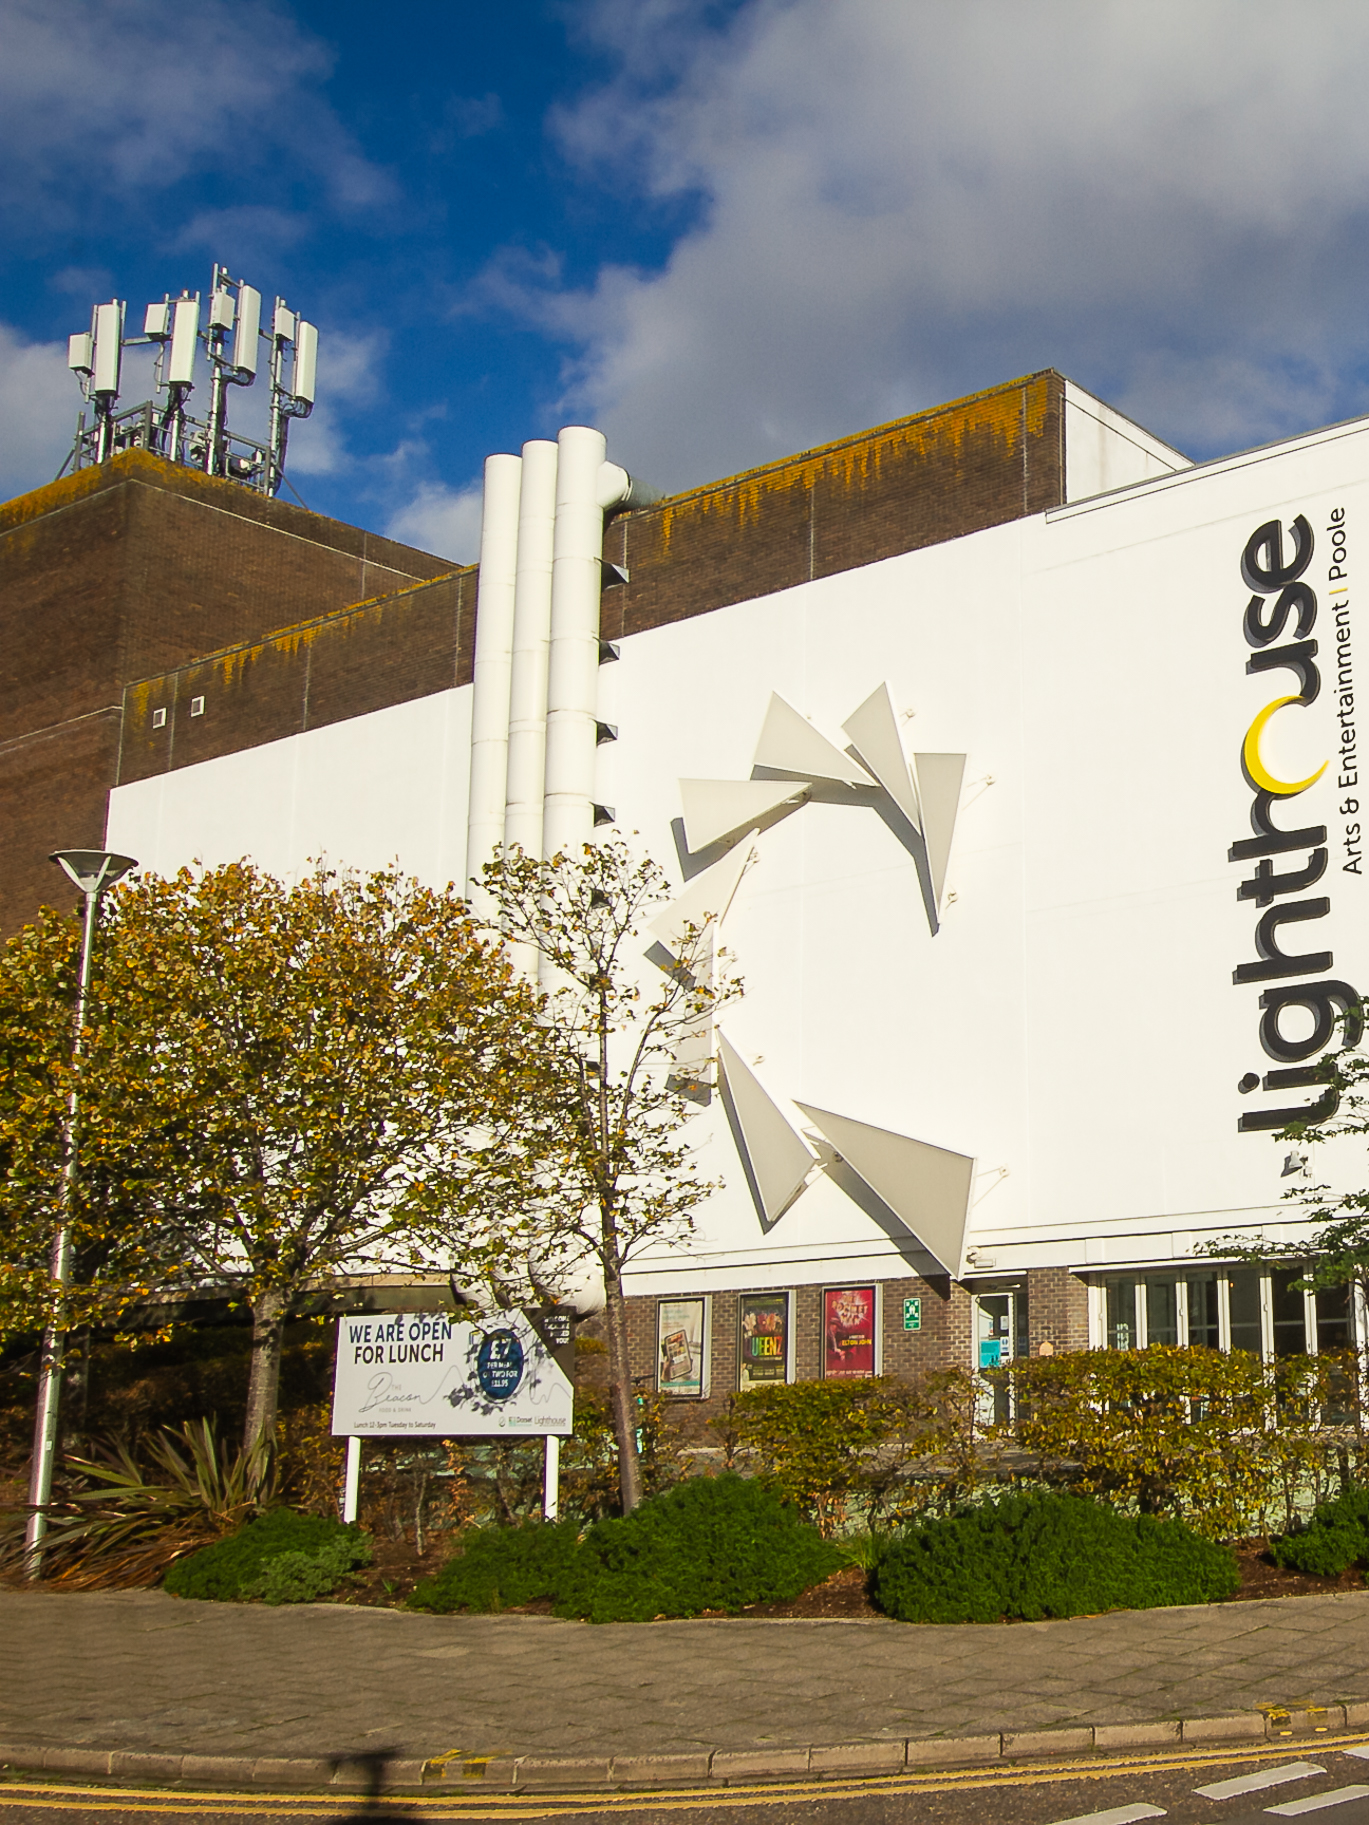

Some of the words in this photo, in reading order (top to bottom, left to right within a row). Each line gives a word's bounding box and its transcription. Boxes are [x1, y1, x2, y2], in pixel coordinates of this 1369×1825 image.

[1326, 507, 1347, 581] Poole
[1331, 599, 1360, 788] Entertainment
[1229, 513, 1364, 1132] lighthouse
[1339, 797, 1360, 816] &
[1342, 824, 1362, 875] Arts
[349, 1325, 372, 1343] WE
[375, 1323, 405, 1342] ARE
[409, 1321, 452, 1341] OPEN
[354, 1345, 384, 1364] FOR
[389, 1343, 444, 1363] LUNCH
[358, 1371, 423, 1413] Beacon
[391, 1383, 402, 1391] THE
[388, 1421, 407, 1430] Tuesday
[414, 1421, 436, 1430] Saturday
